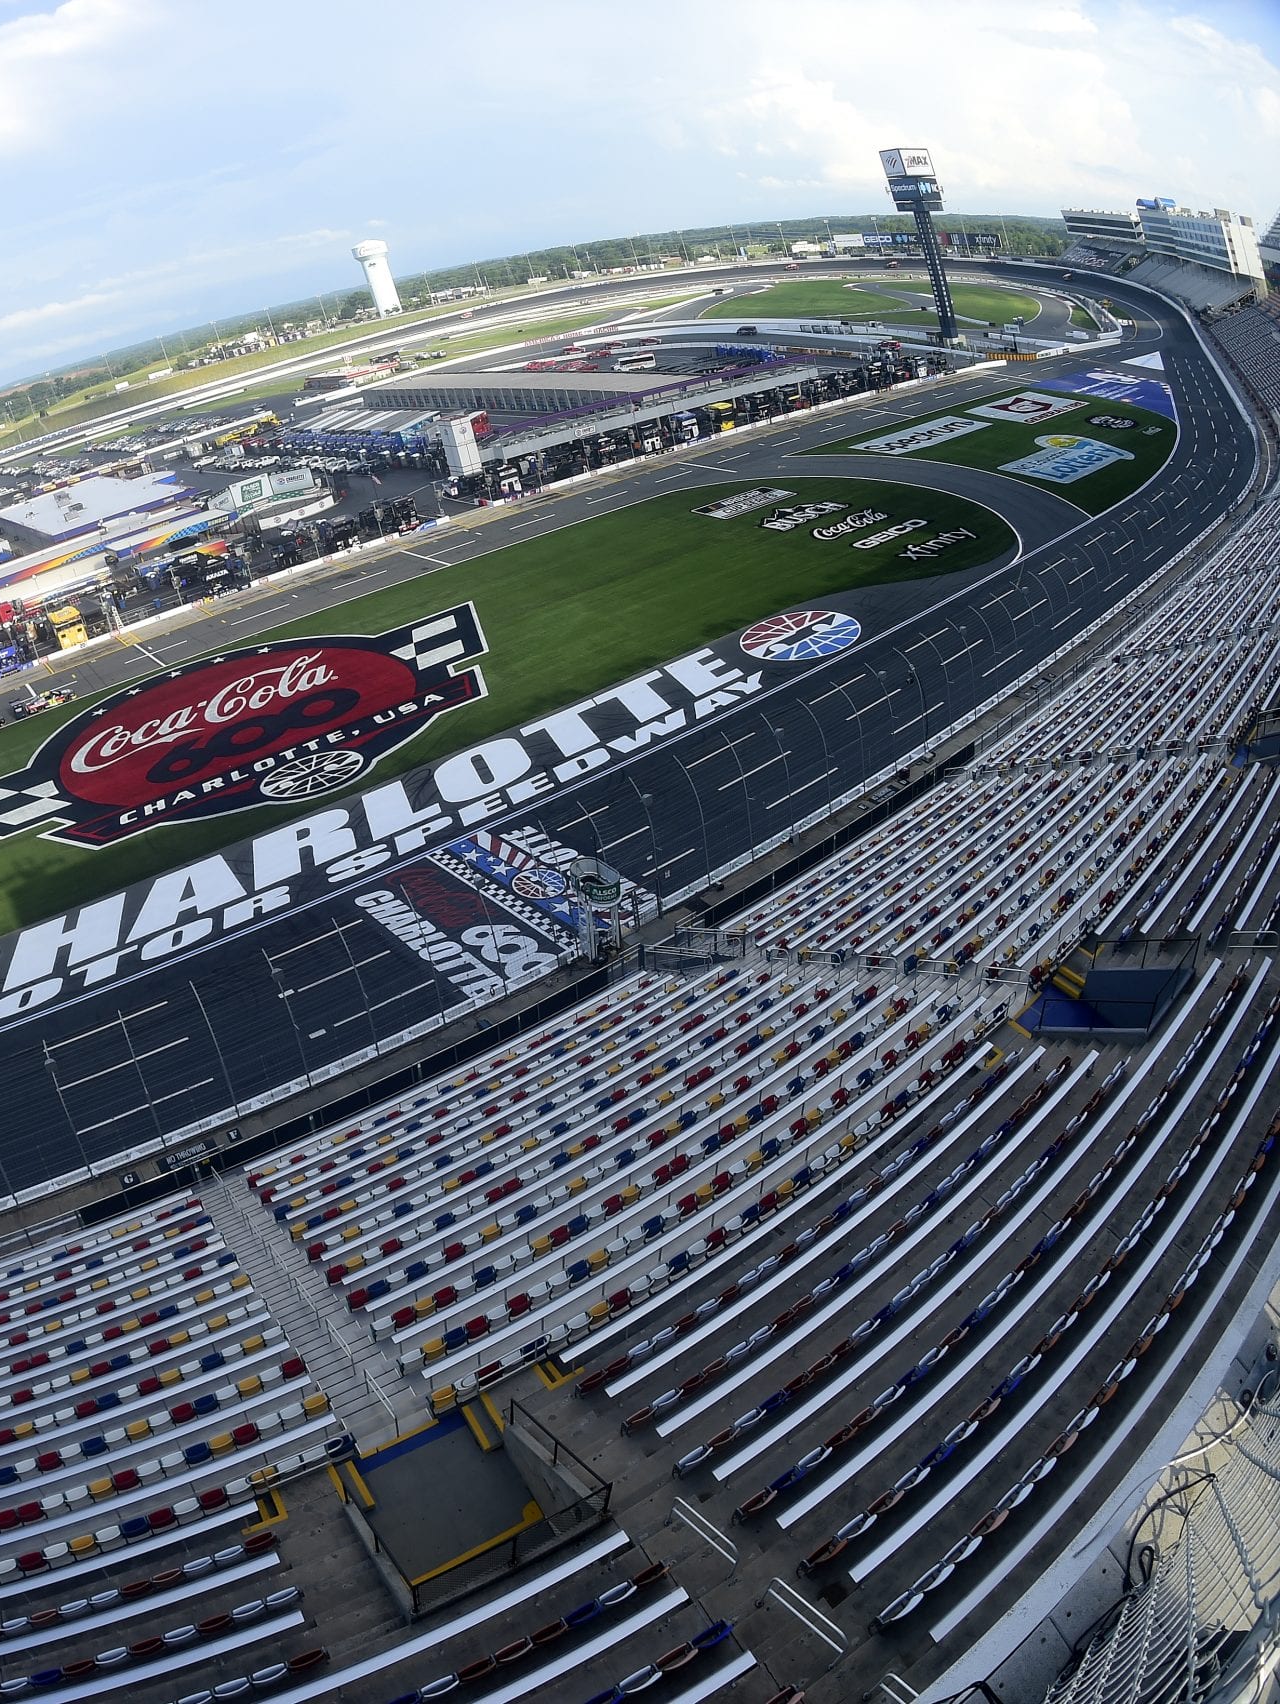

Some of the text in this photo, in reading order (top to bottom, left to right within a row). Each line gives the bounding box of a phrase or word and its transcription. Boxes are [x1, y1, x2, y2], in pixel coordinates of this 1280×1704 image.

[864, 235, 891, 243] GEICO
[974, 234, 997, 245] xfinity
[864, 420, 970, 452] Spectrum
[1029, 446, 1124, 479] Lottery
[762, 500, 848, 532] BUSCH
[813, 508, 888, 541] Coca-Cola
[853, 519, 928, 550] GEICO
[898, 527, 977, 561] xfinity
[206, 569, 229, 581] AXALTA
[71, 650, 334, 773] Coca-Cola
[145, 687, 361, 783] 600
[120, 693, 444, 826] CHARLOTTE, USA
[326, 670, 764, 883] SPEEDWAY
[592, 887, 617, 896] ALSCO
[175, 1142, 207, 1161] THROWING
